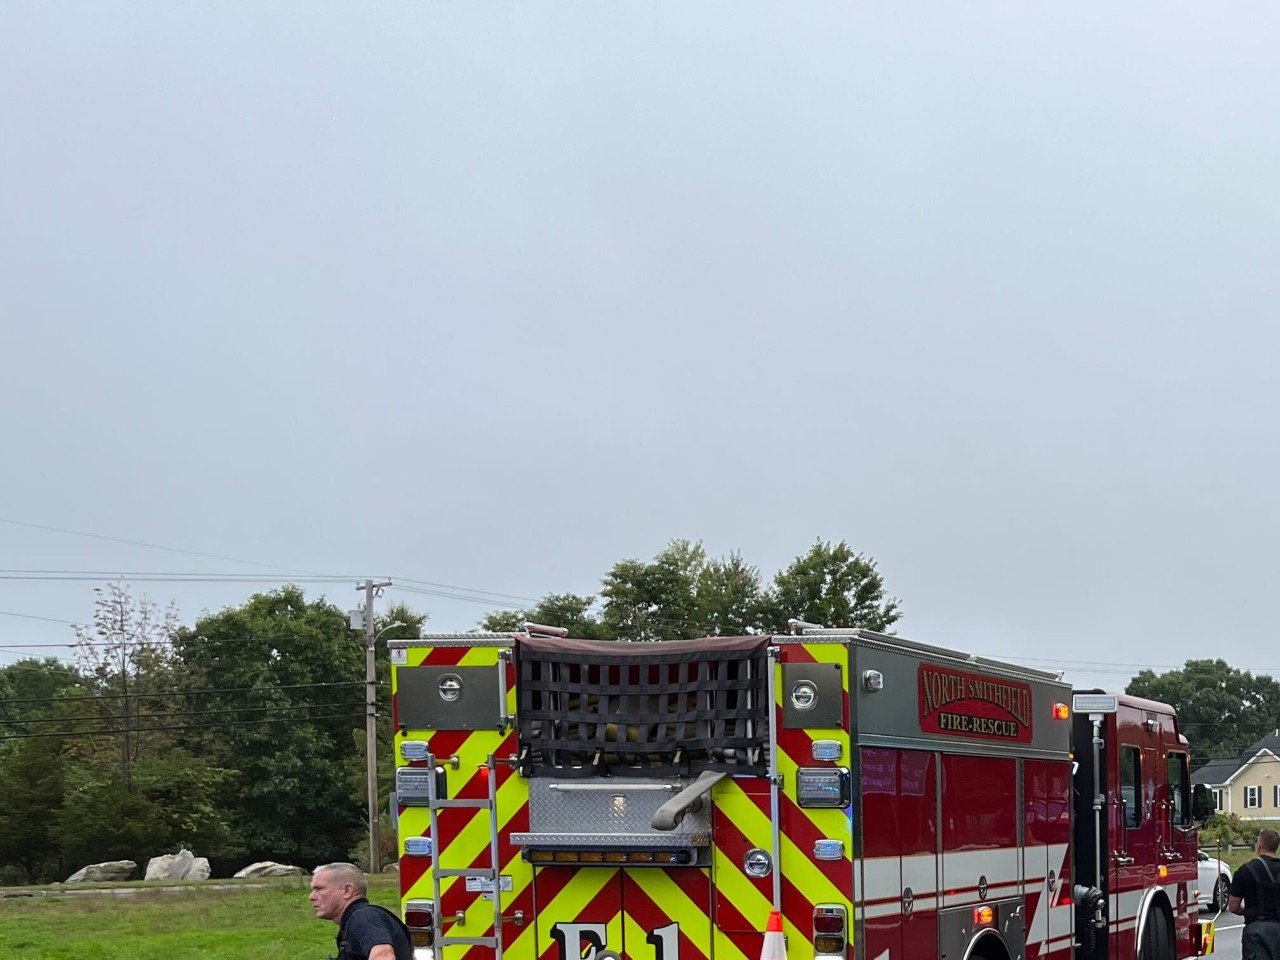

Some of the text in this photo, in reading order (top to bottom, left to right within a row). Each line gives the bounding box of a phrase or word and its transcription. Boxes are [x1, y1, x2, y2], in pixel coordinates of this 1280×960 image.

[923, 670, 1028, 728] NORTH SMITHFIELD
[939, 712, 1018, 737] FIRE-RESCUE
